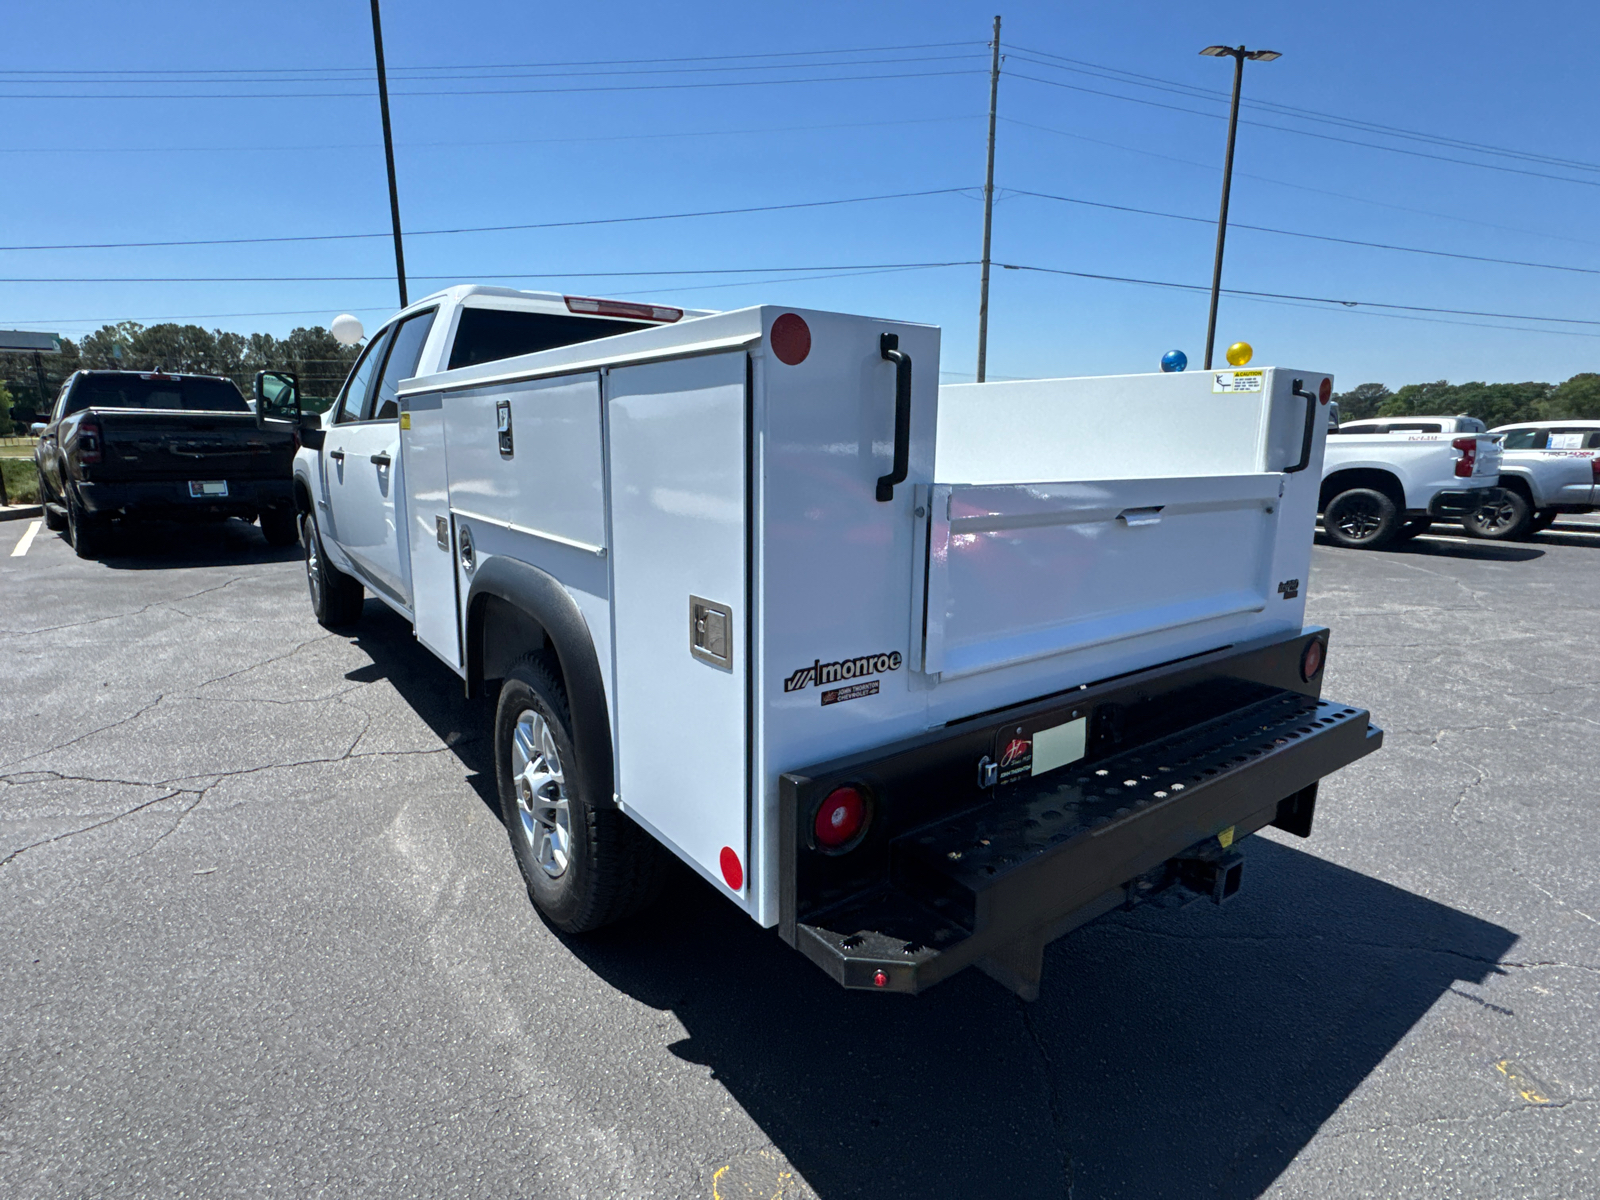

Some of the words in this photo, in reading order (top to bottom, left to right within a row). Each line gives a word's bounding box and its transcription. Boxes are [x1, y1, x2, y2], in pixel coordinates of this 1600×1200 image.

[821, 651, 902, 684] monroe
[837, 689, 869, 701] CHEVROLET
[838, 687, 852, 696] JOHN
[852, 681, 879, 692] THORNTON
